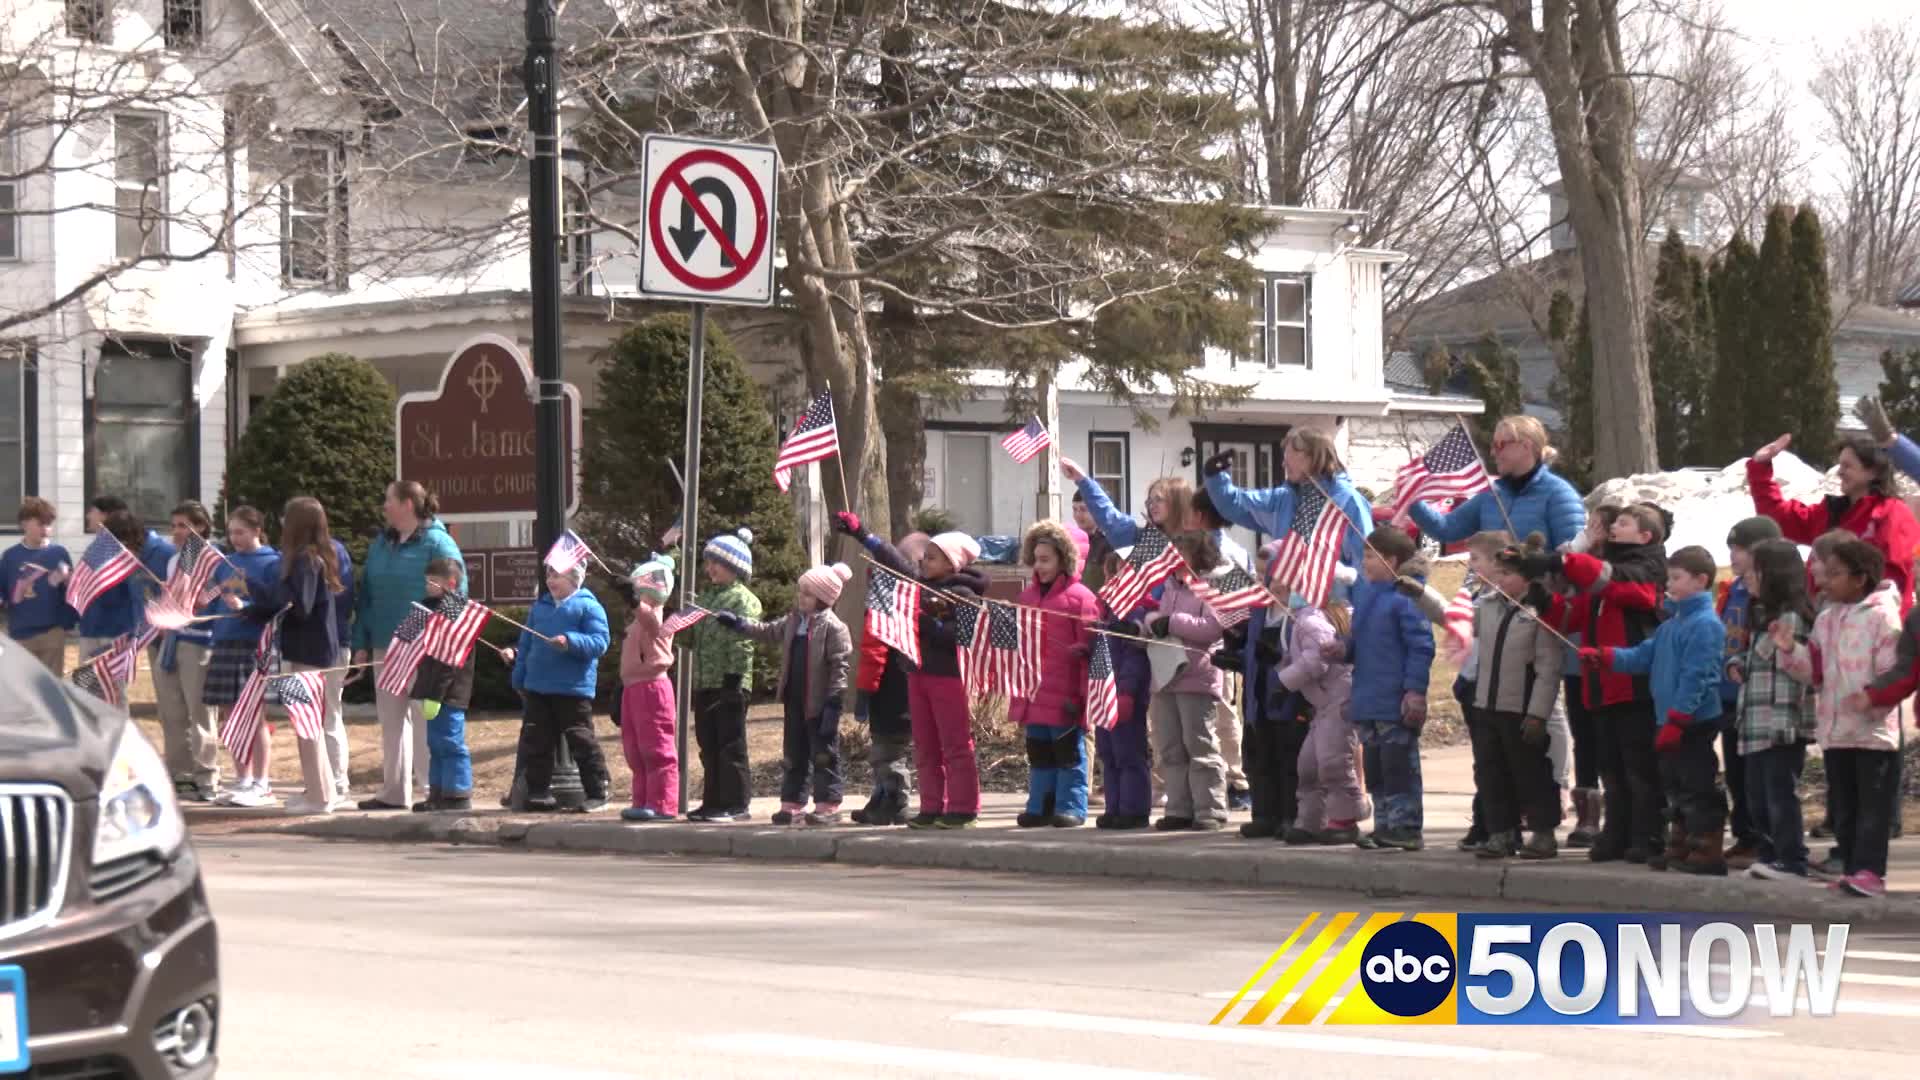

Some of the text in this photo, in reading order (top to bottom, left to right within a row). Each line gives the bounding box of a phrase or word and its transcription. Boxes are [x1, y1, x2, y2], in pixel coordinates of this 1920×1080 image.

[462, 419, 536, 459] Jame
[424, 472, 536, 496] ATHOLIC CHUR
